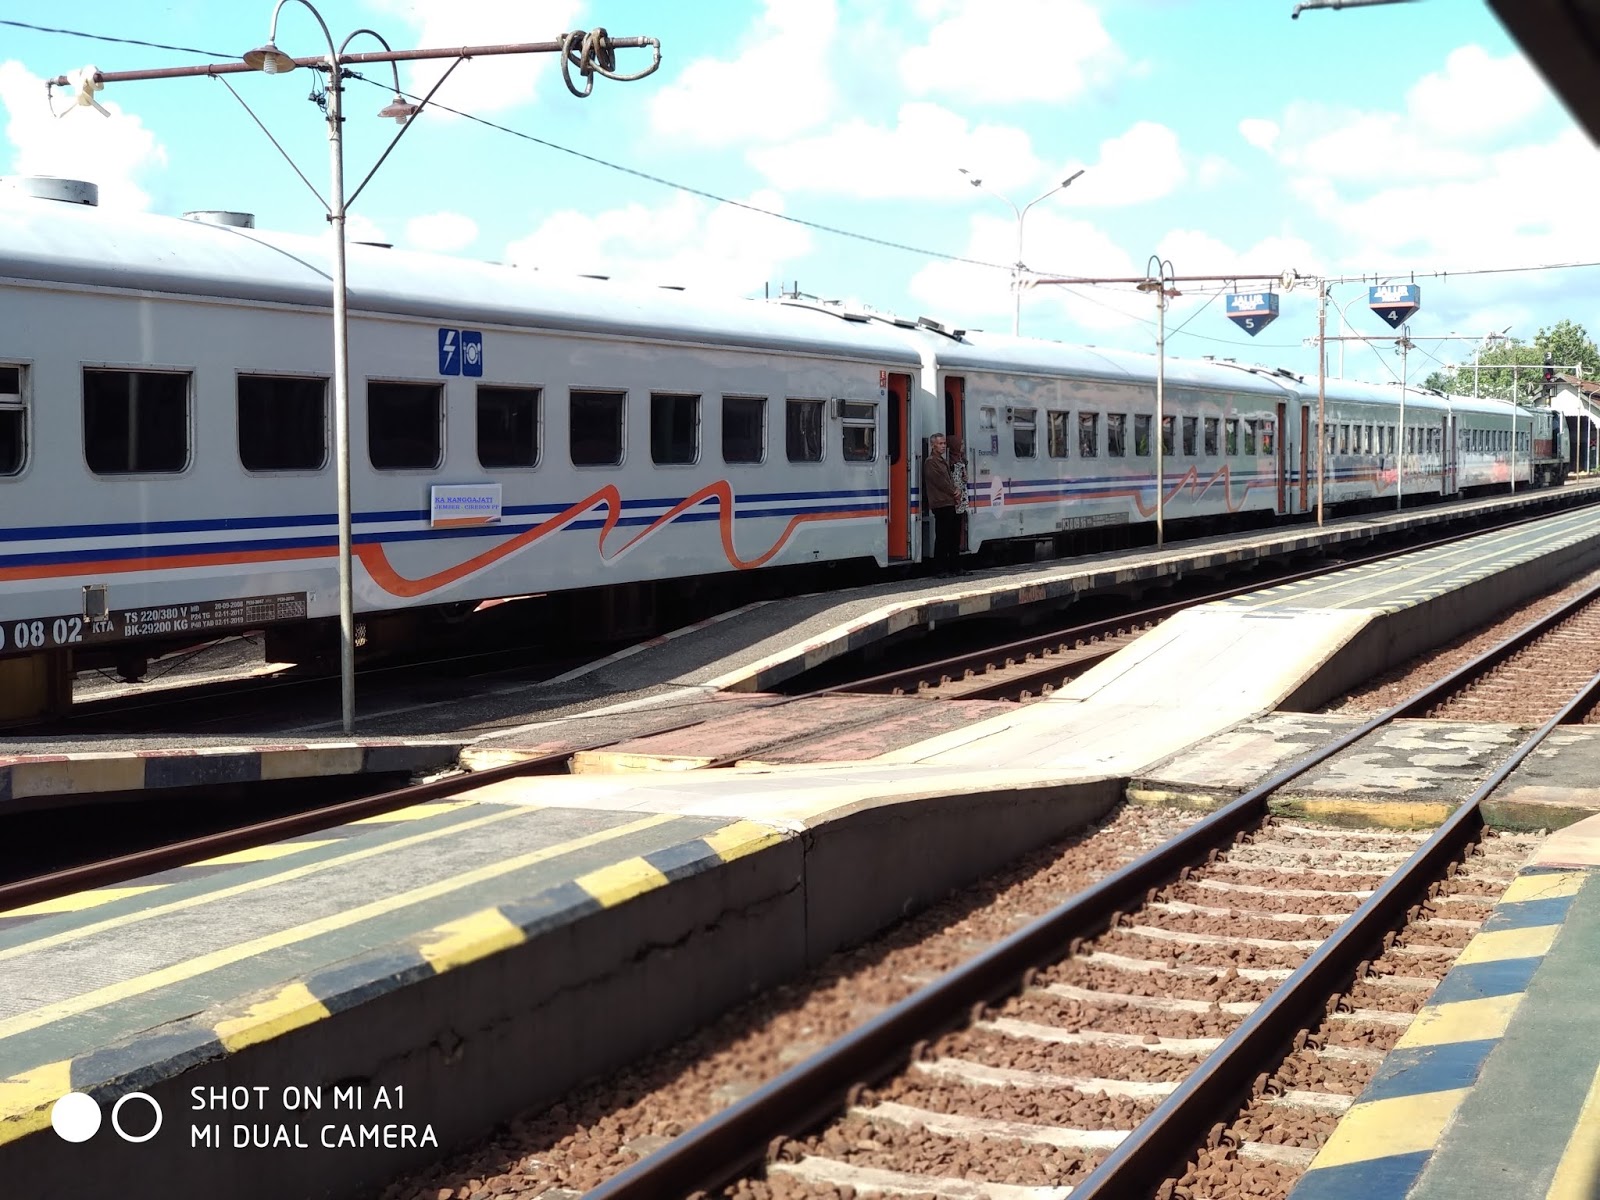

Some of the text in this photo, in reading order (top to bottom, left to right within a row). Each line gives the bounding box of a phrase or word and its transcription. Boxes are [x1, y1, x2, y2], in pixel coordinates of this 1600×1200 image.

[1387, 311, 1398, 321] 4
[1245, 318, 1255, 329] 5
[124, 606, 188, 623] TS 220/380 V
[214, 608, 244, 618] 02-11-2017
[214, 617, 244, 626] 02-11-2019
[14, 621, 45, 649] 08
[52, 617, 83, 645] 02
[92, 620, 114, 634] KTA
[124, 619, 189, 637] BK-29200 KG
